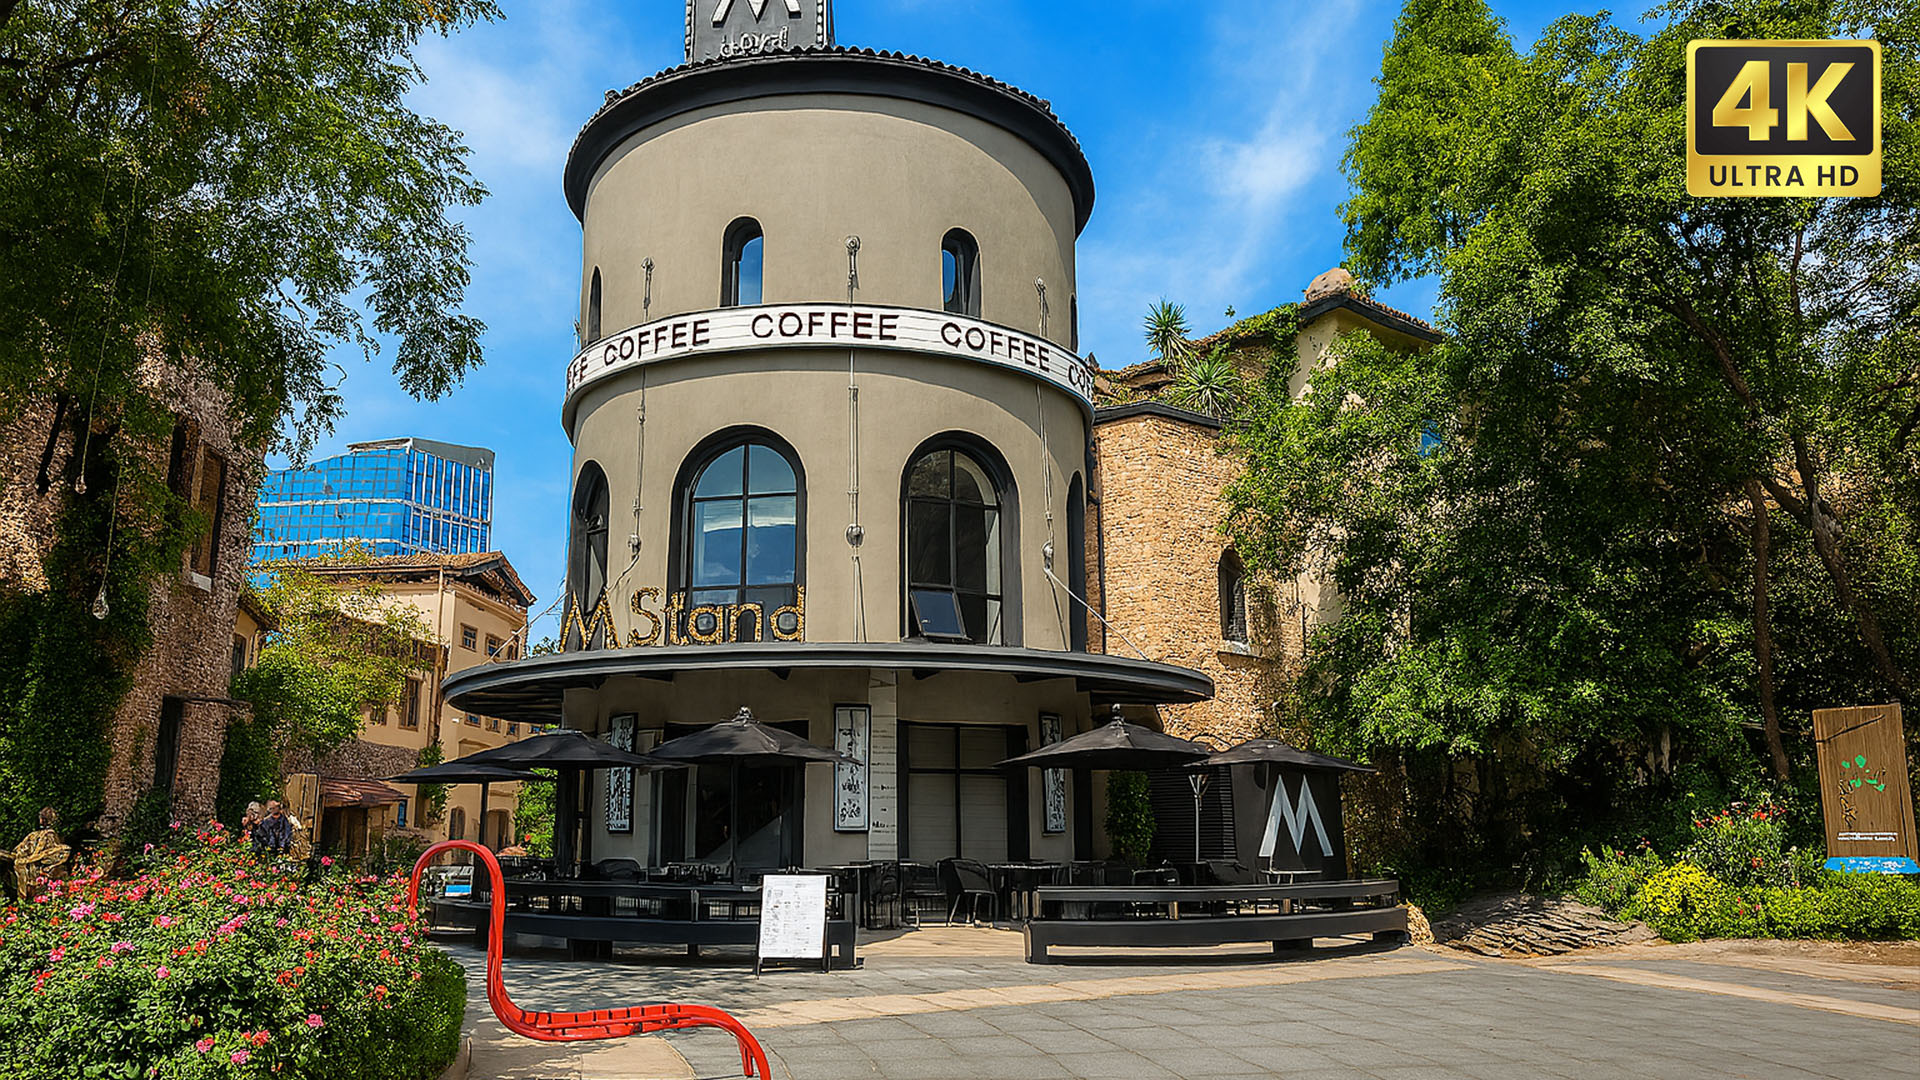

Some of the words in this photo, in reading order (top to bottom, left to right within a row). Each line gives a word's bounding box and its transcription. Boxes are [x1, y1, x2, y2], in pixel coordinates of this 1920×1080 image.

[604, 319, 710, 366] COFFEE
[751, 312, 899, 341] COFFEE
[941, 322, 1051, 373] COFFEE
